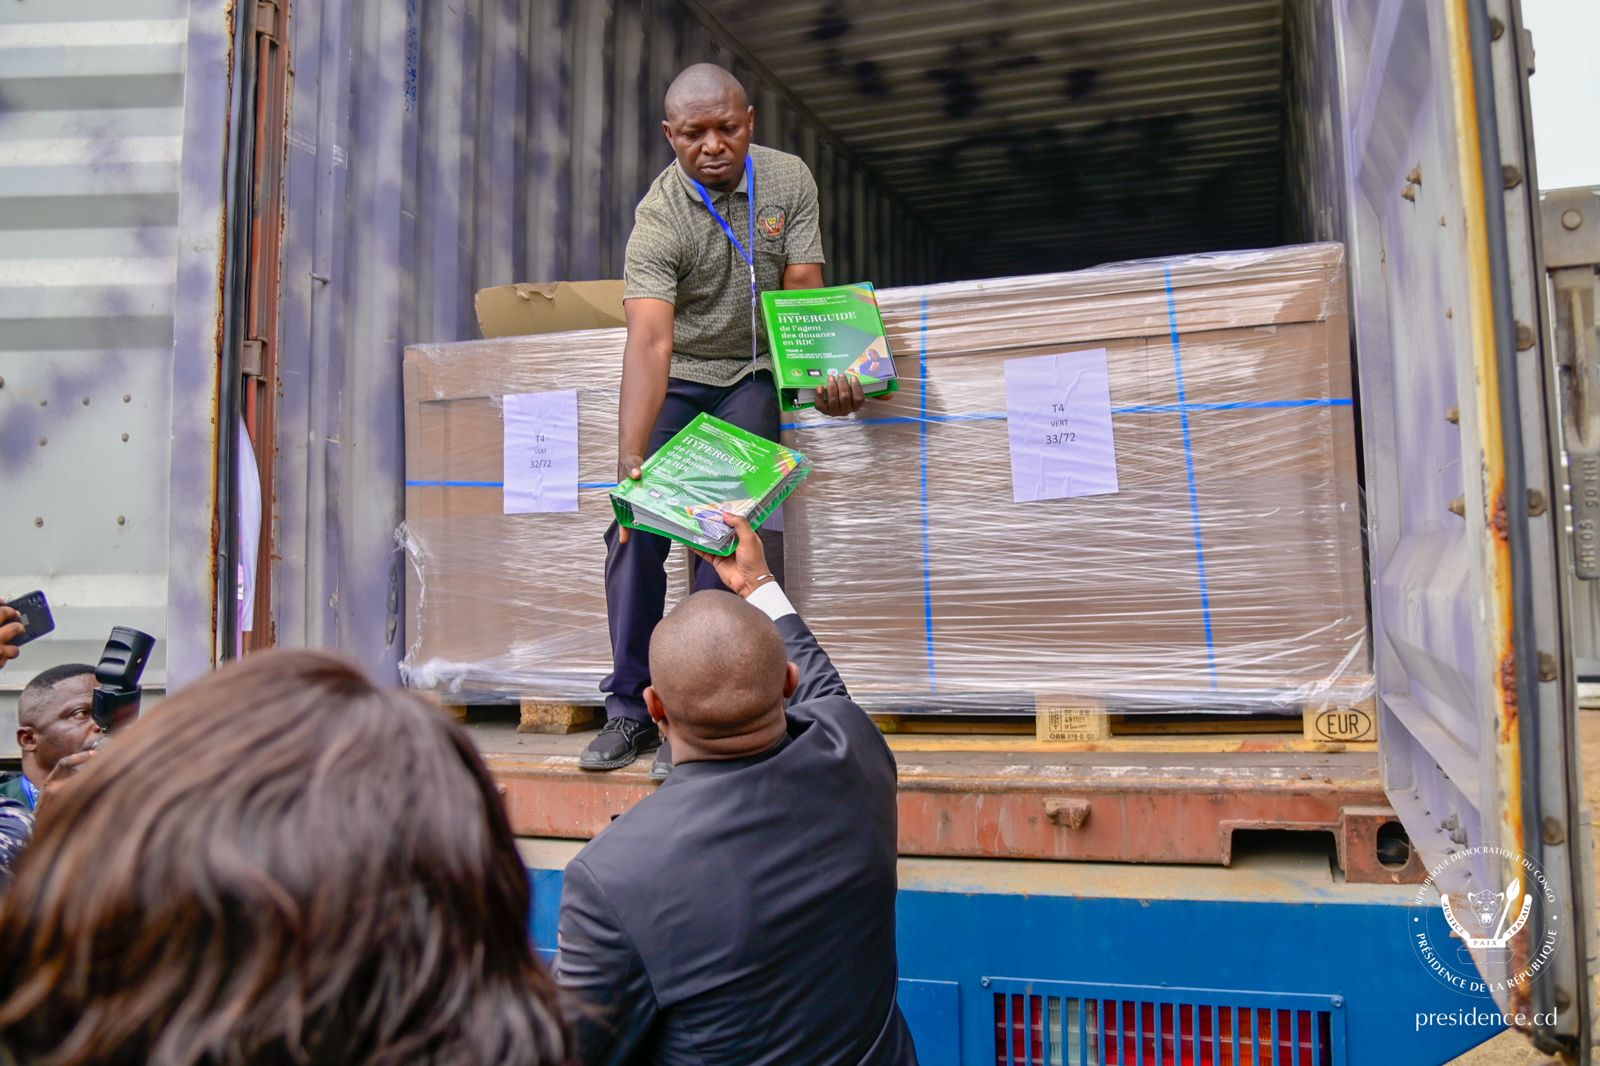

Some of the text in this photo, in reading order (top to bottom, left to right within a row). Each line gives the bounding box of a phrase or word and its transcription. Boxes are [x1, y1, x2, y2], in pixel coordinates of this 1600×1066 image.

[778, 312, 856, 324] HYPERGUIDE
[1052, 404, 1064, 413] T4
[1046, 432, 1076, 444] 33/72
[682, 436, 759, 473] HYPERGUIDE
[530, 460, 552, 468] 32/72
[1327, 714, 1358, 734] EUR
